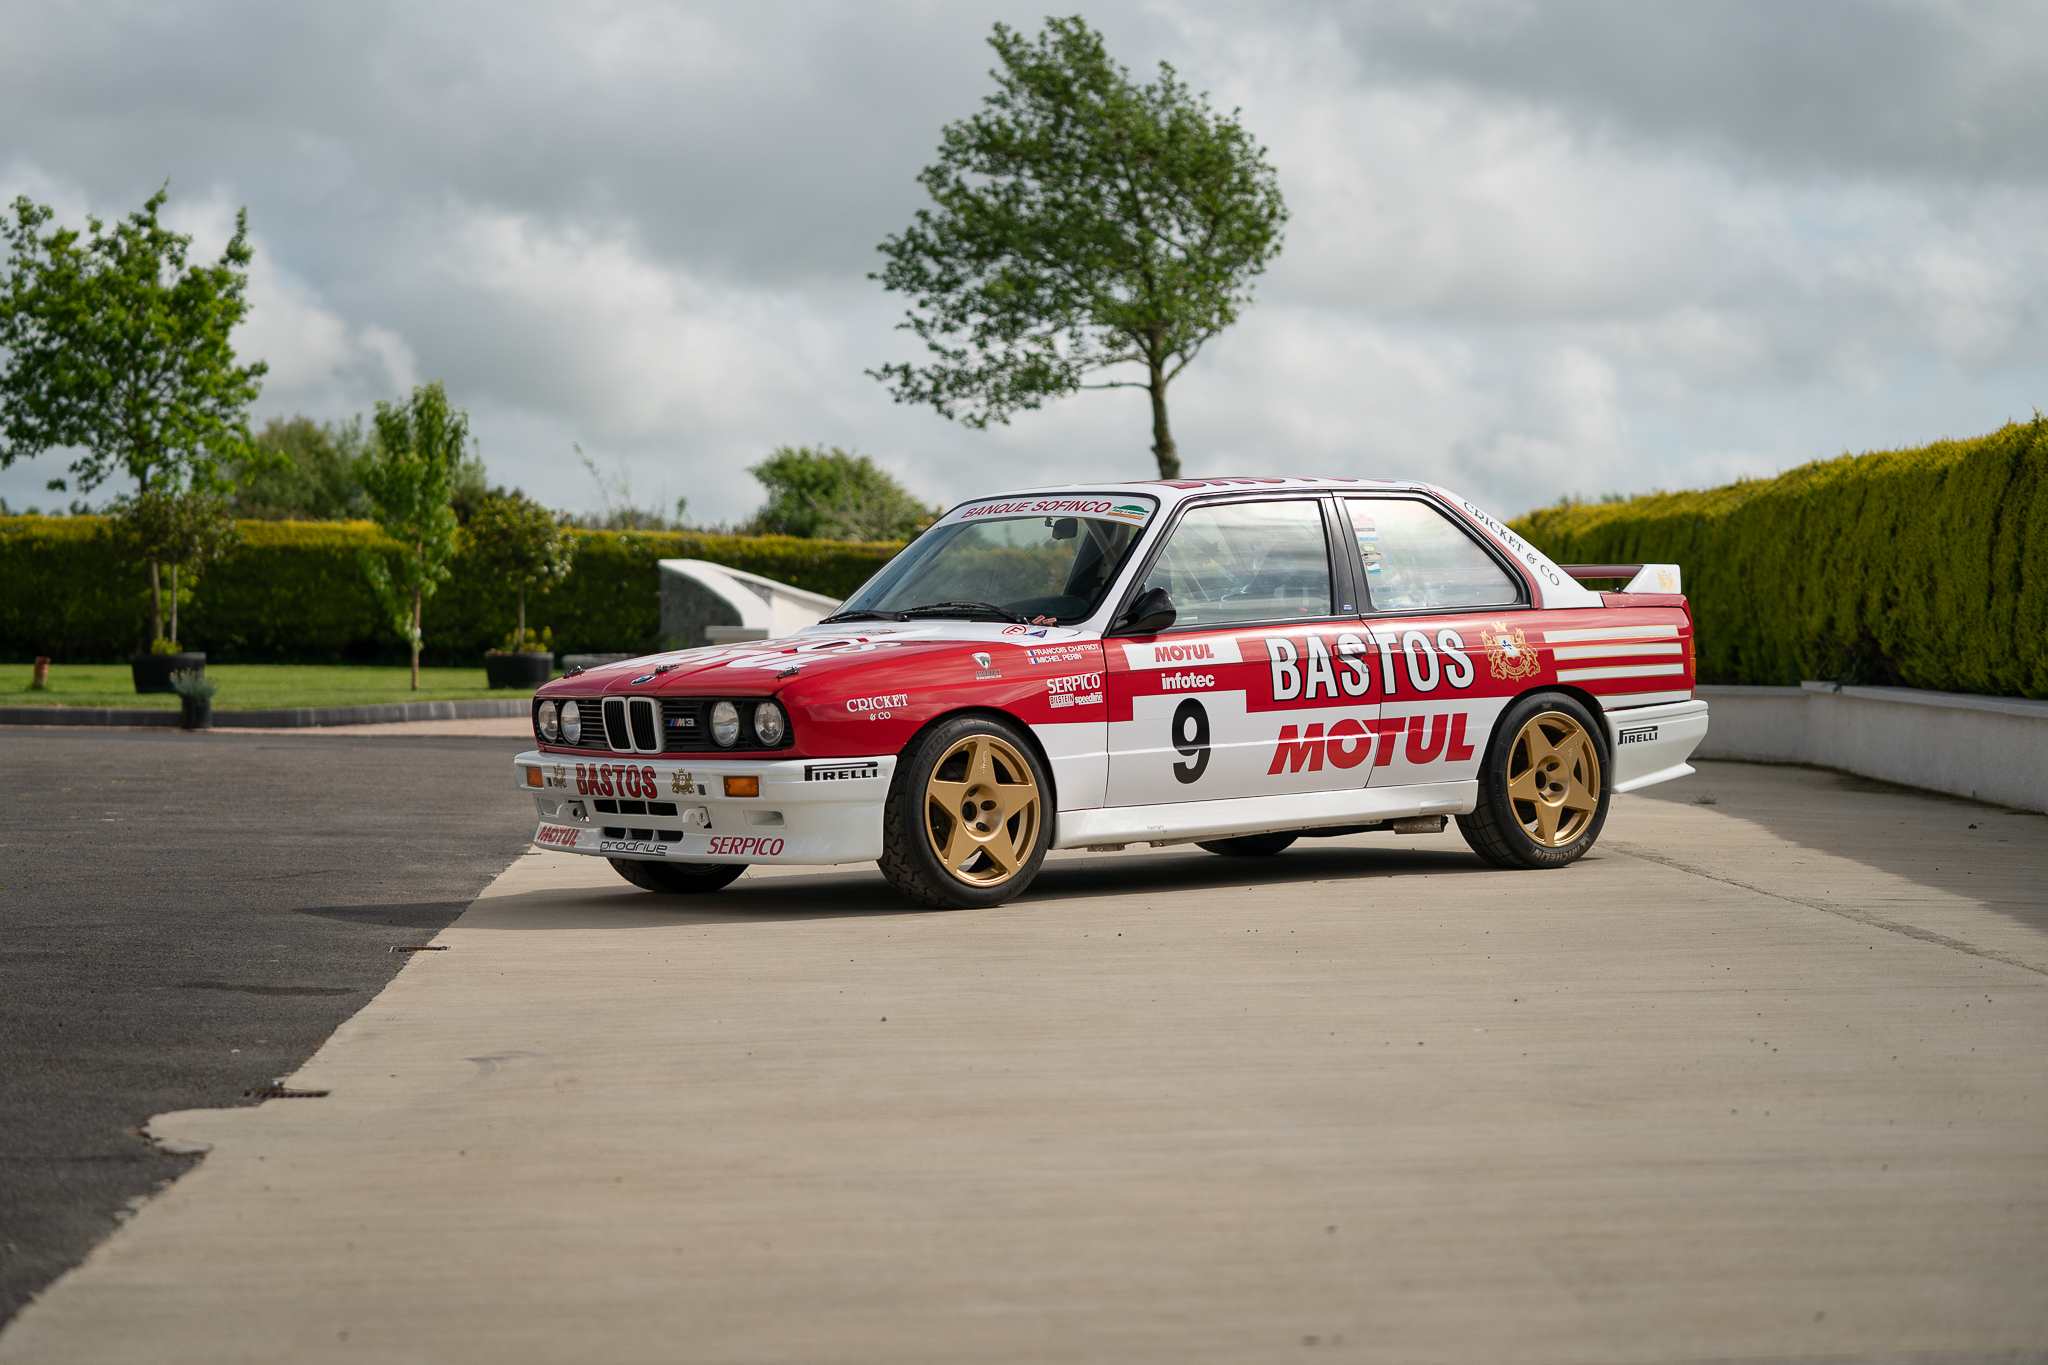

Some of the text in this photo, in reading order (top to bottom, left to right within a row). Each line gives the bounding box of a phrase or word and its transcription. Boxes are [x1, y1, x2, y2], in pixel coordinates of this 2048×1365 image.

[961, 501, 1033, 519] BANQUE
[1031, 500, 1112, 513] SOFINCO
[1464, 501, 1560, 586] CRICKET & CO
[1033, 643, 1099, 656] FRANCOIS CHATRIOT
[1037, 653, 1082, 663] MICHEL PERIN
[1154, 643, 1215, 663] MOTUL
[1264, 628, 1475, 701] BASTOS
[1046, 674, 1101, 694] SERPICO
[1161, 672, 1215, 690] infotec
[846, 693, 909, 713] CRICKET
[1049, 692, 1103, 704] BILSTEIN speedline
[676, 718, 695, 727] M3
[870, 711, 891, 722] & CO
[1171, 697, 1212, 784] 9
[1267, 713, 1475, 775] MOTUL
[1618, 725, 1659, 746] PIRELLI
[575, 763, 658, 799] BASTOS
[803, 761, 879, 782] PIRELLI
[537, 825, 580, 848] MOTUL
[706, 837, 785, 856] SERPICO
[600, 841, 667, 857] prodrive
[1533, 845, 1581, 862] MICHELIN
